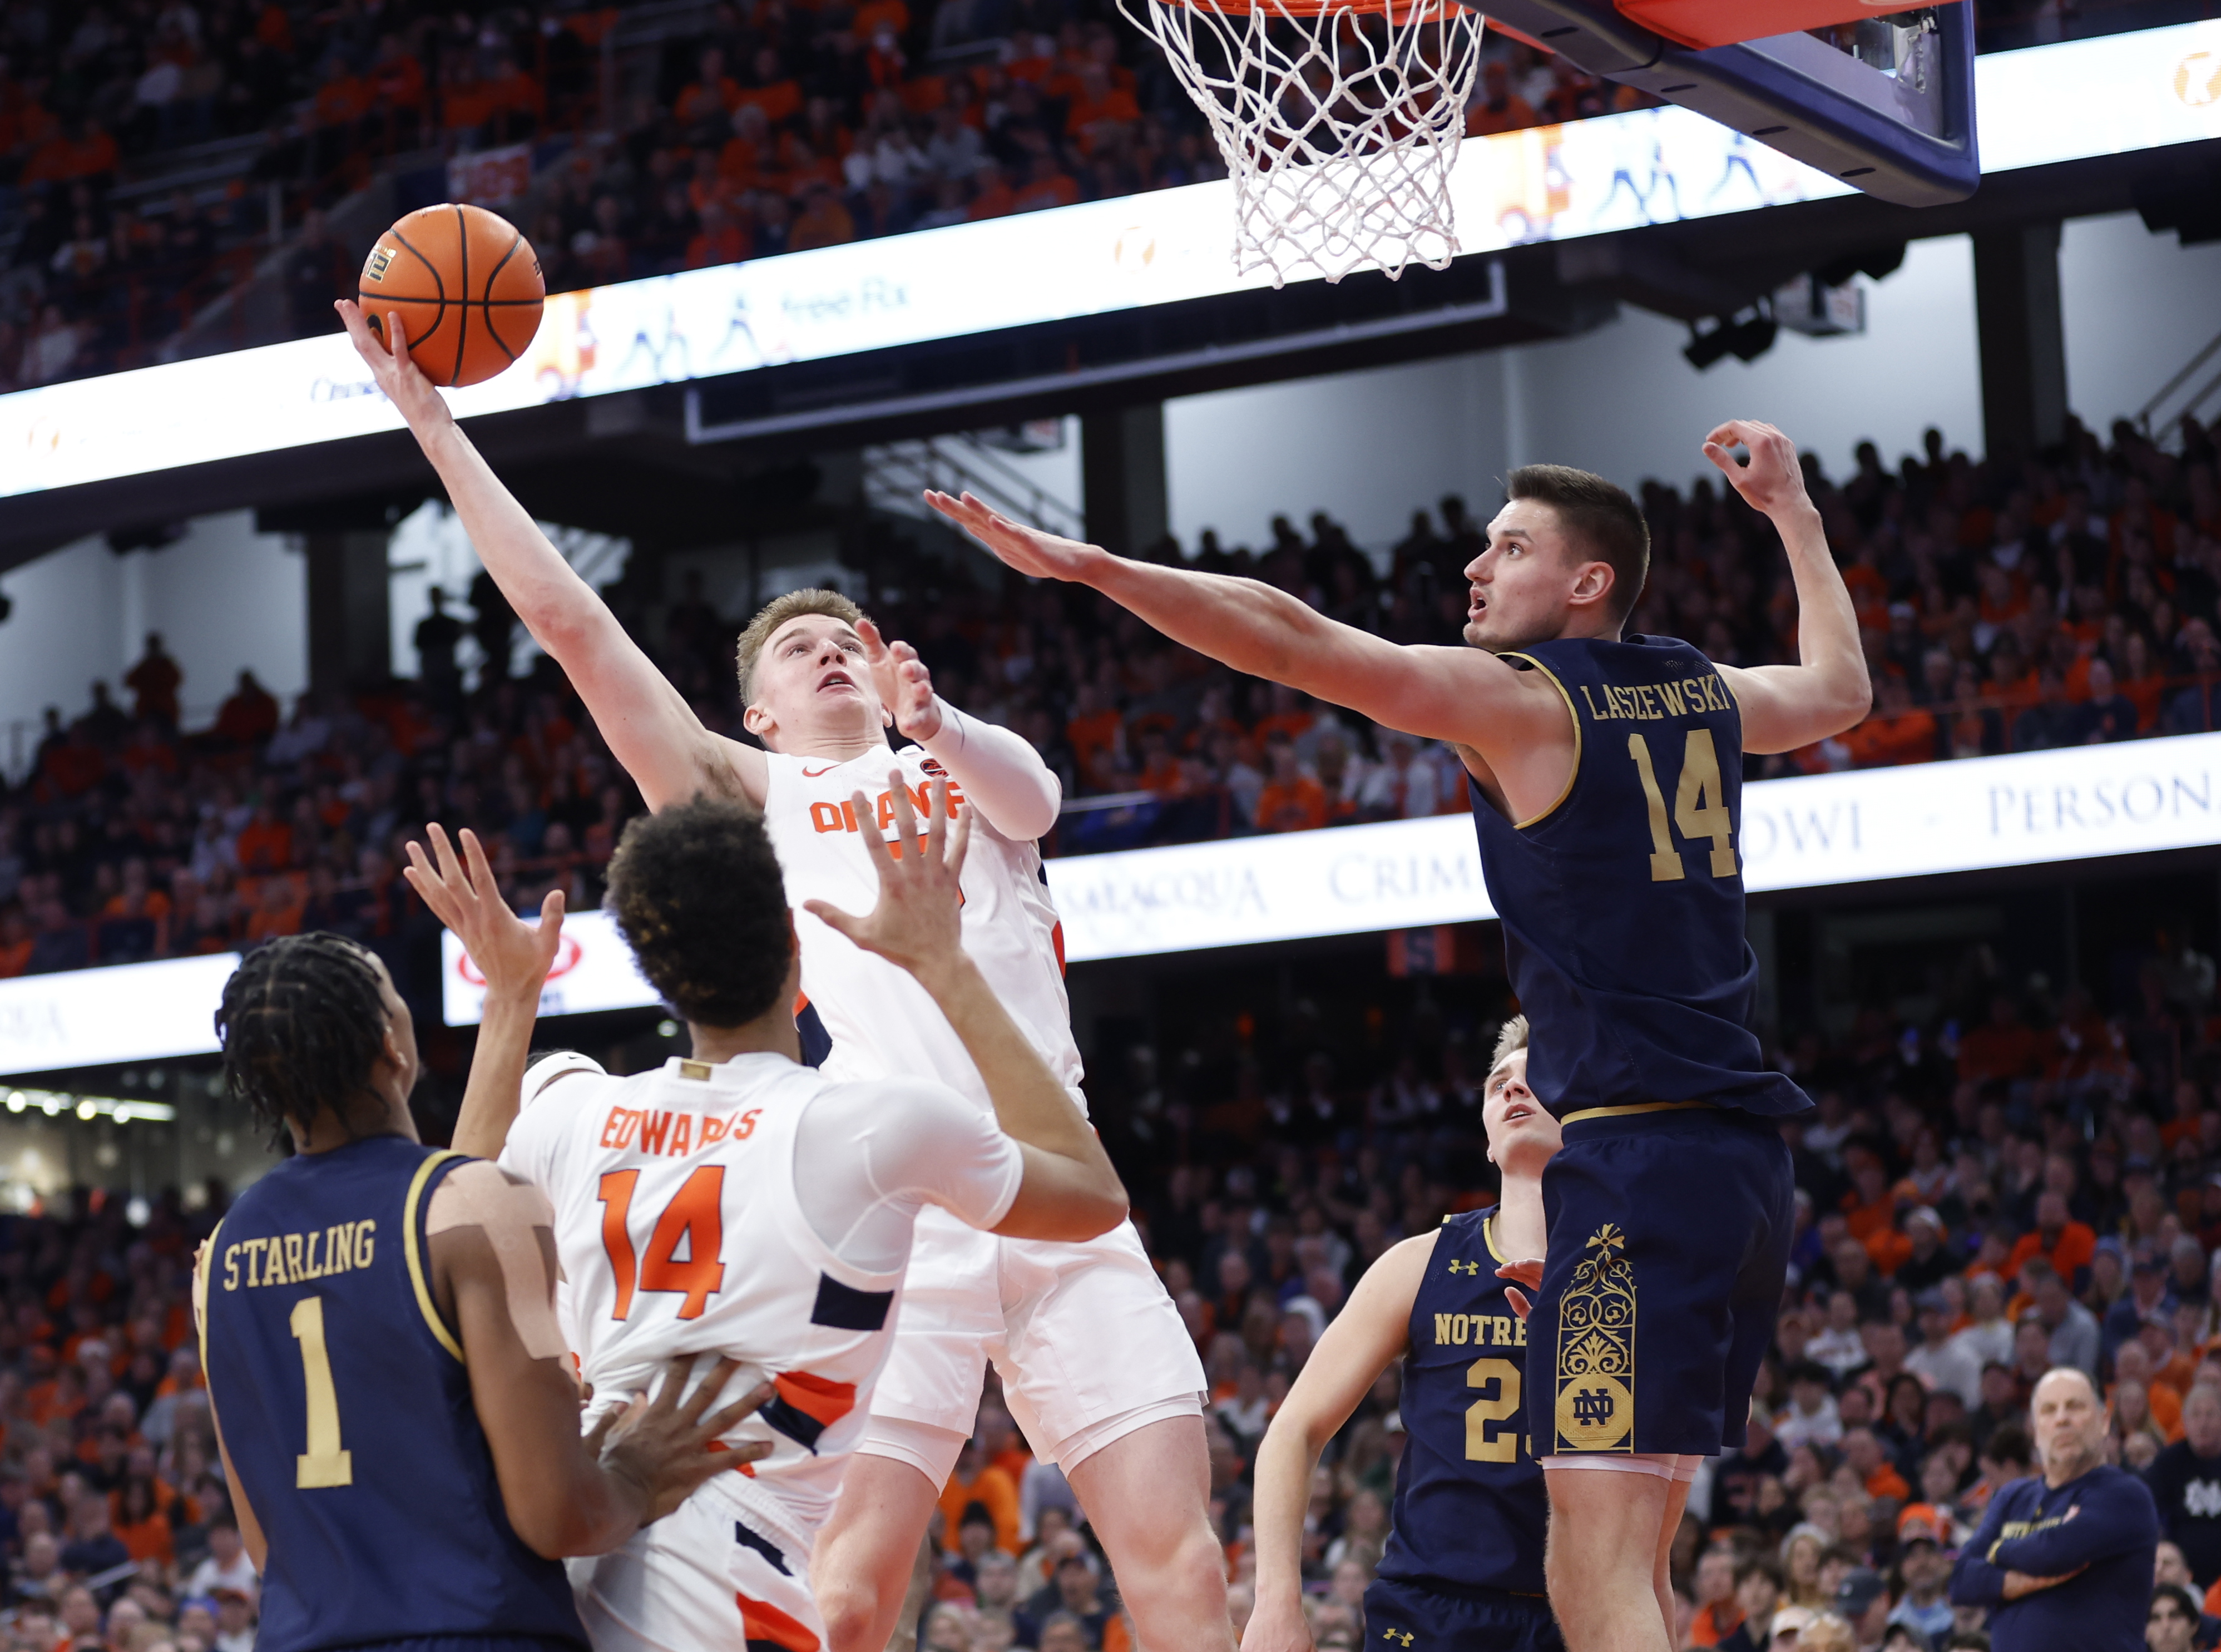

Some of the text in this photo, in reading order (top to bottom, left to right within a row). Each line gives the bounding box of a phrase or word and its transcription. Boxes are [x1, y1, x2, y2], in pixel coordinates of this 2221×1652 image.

[1580, 674, 1731, 720] LASZEWSKI
[1628, 728, 1738, 882] 14
[1741, 799, 1861, 863] DWI
[223, 1219, 377, 1292] STARLING
[597, 1164, 726, 1321] 14
[1434, 1313, 1527, 1347] NOTRE
[289, 1295, 353, 1489] 1
[1465, 1358, 1542, 1466] 2
